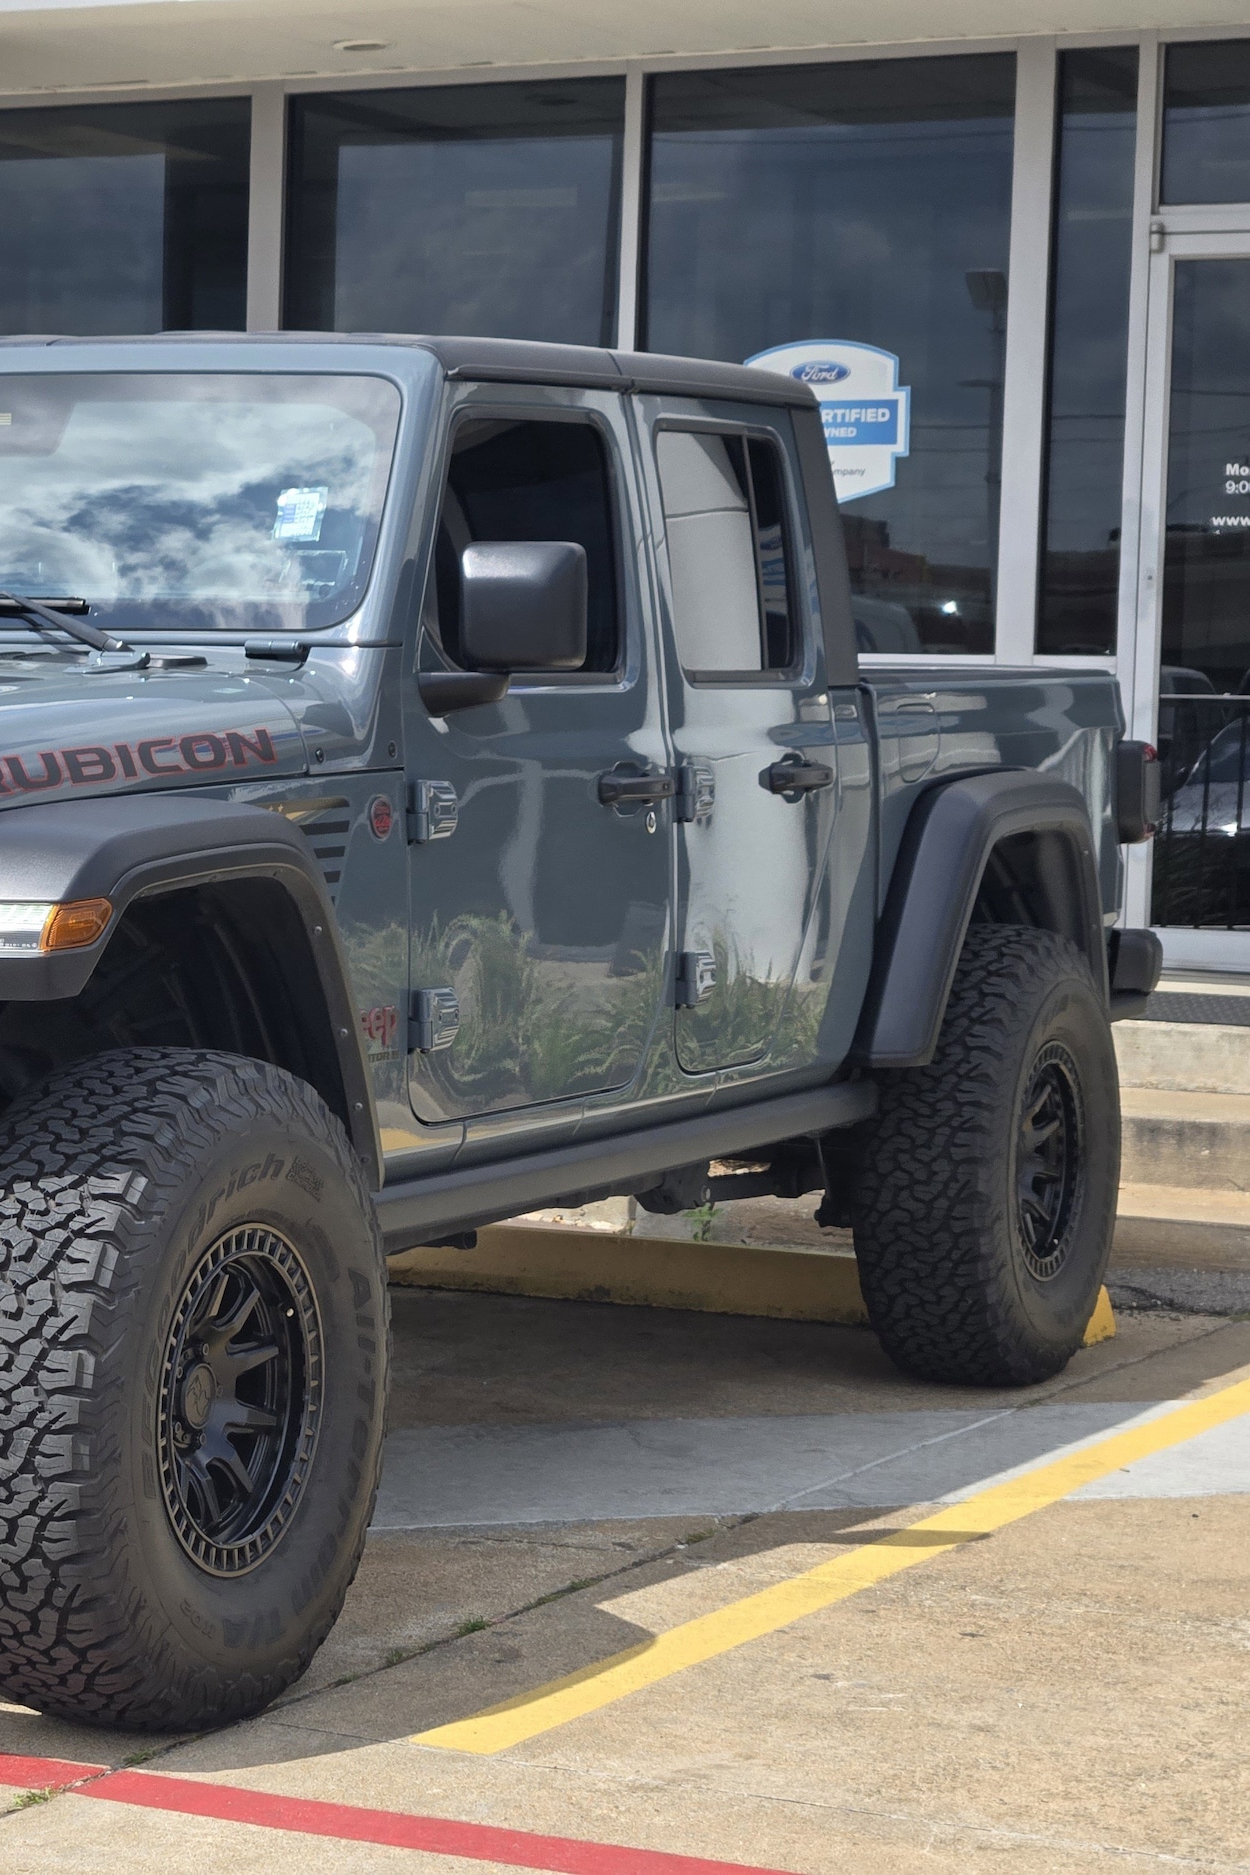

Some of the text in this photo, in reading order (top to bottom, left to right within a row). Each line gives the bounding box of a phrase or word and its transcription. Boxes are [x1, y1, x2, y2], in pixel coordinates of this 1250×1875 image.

[799, 362, 839, 380] Ford
[820, 407, 891, 424] RTIFIED
[833, 467, 864, 477] mpany
[1226, 463, 1250, 477] Mo
[1225, 480, 1250, 494] 9:0
[359, 1005, 396, 1046] eep
